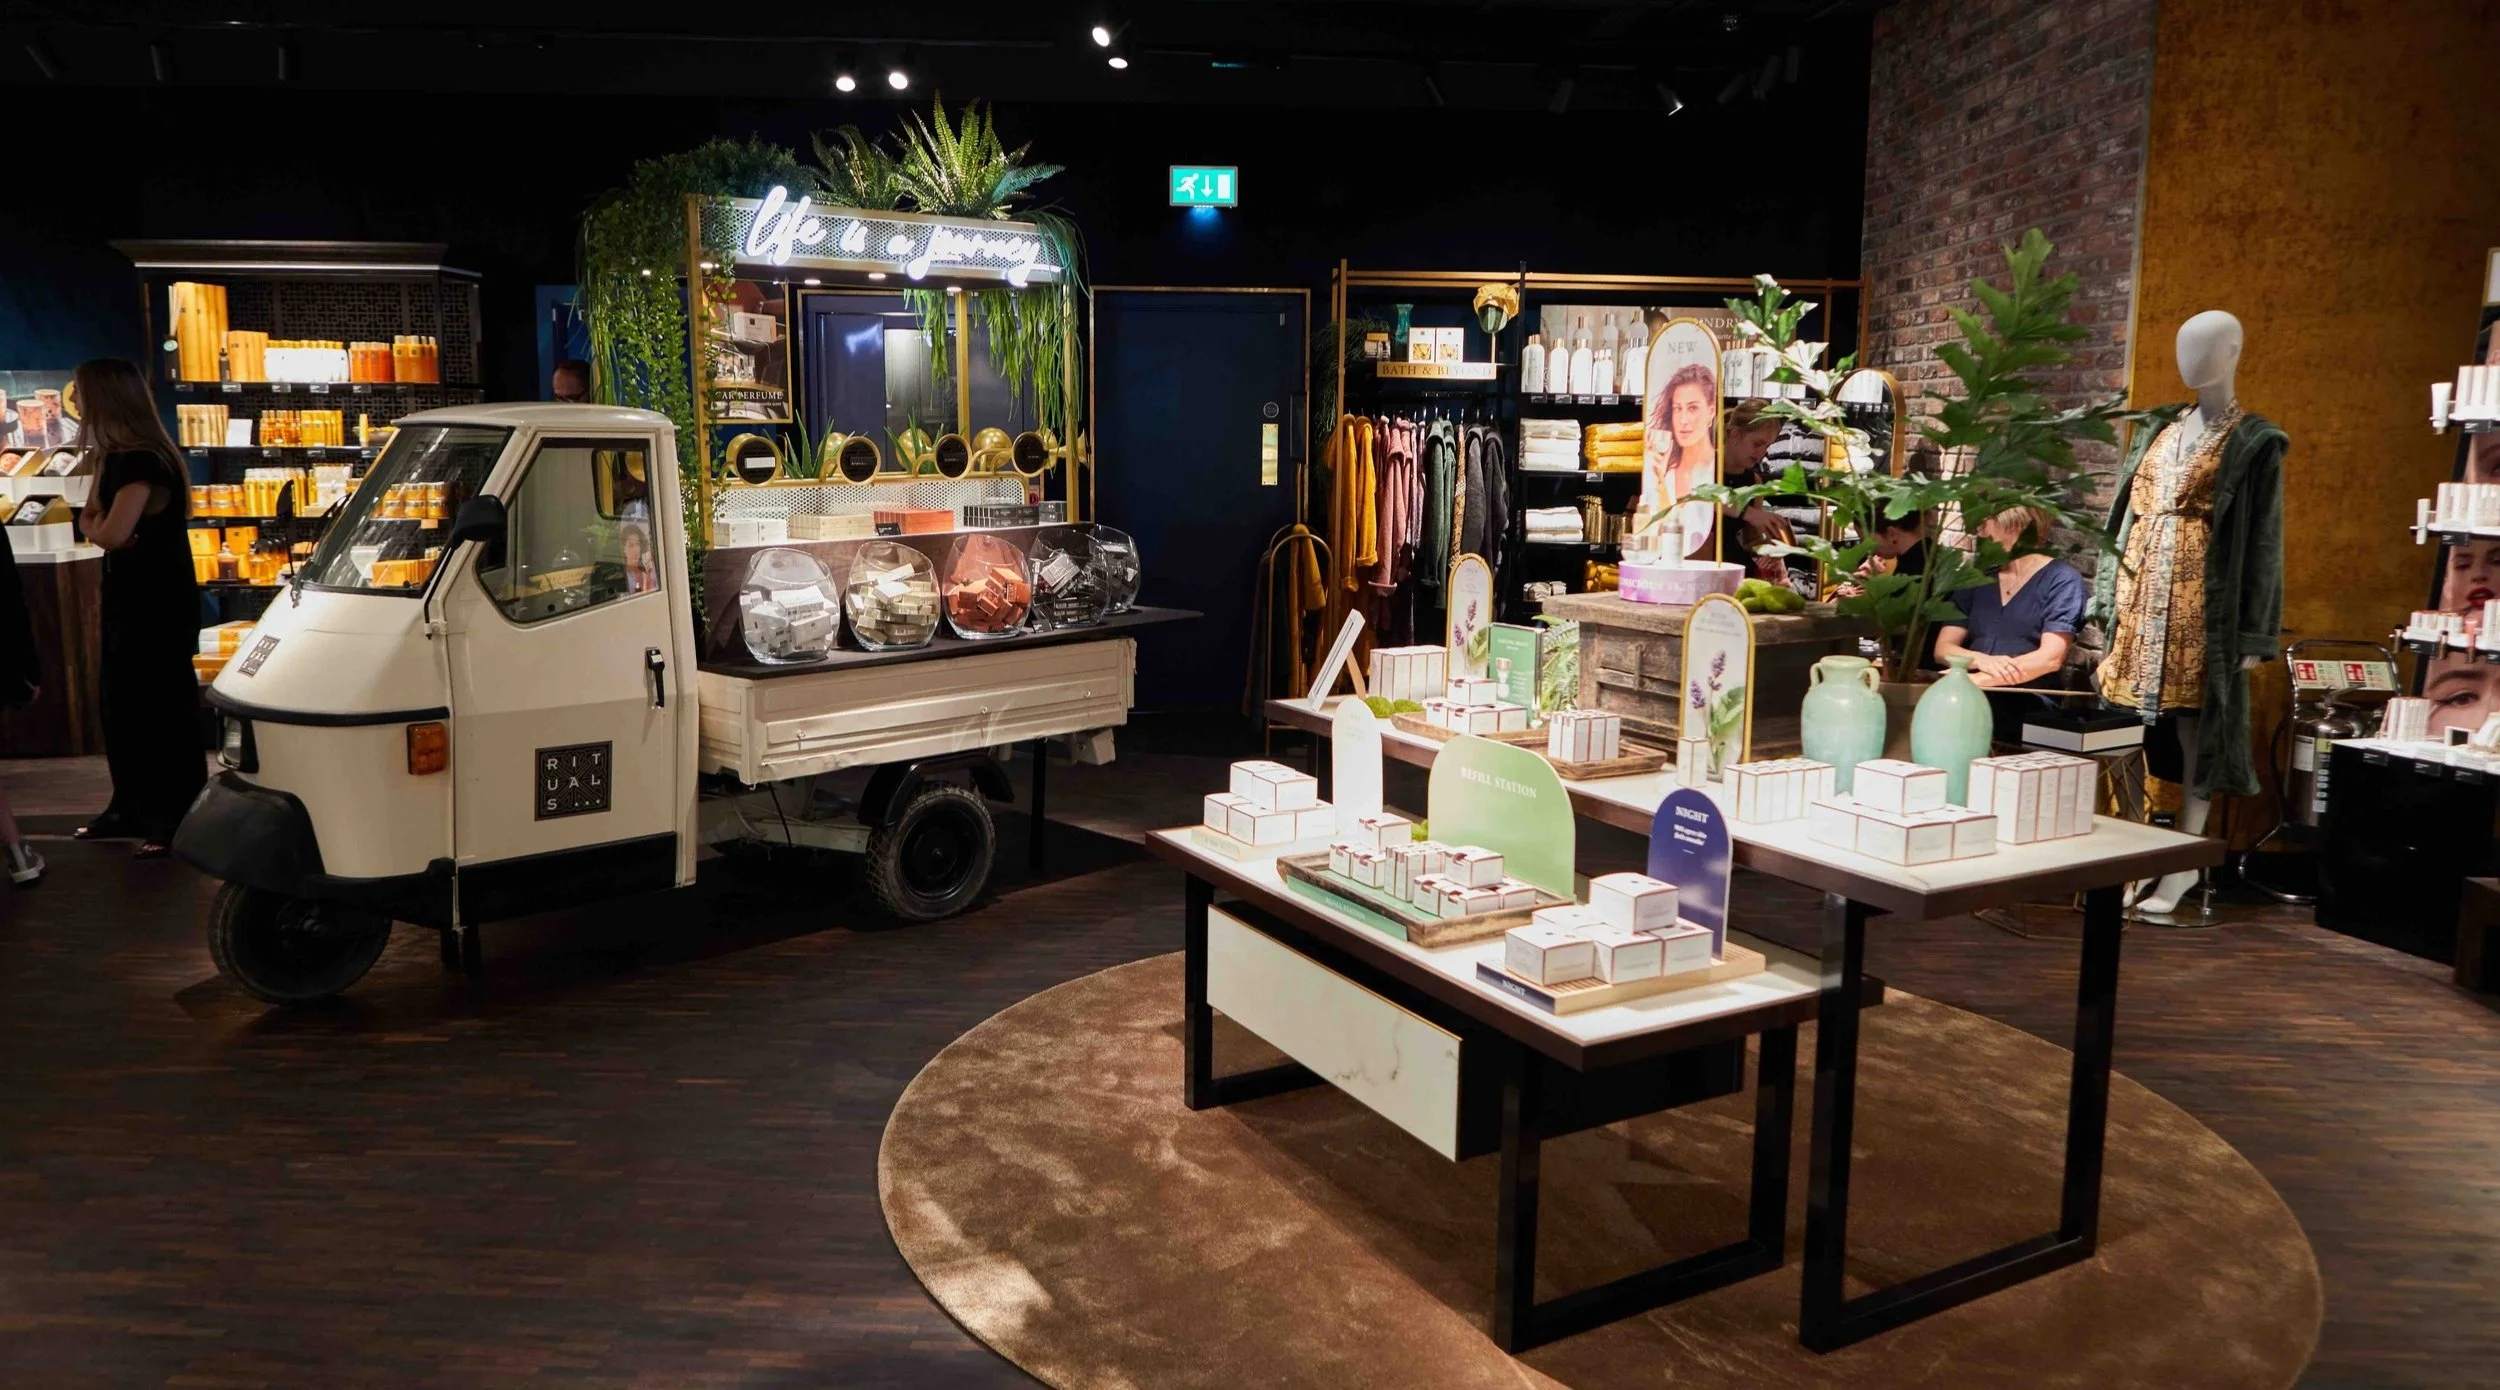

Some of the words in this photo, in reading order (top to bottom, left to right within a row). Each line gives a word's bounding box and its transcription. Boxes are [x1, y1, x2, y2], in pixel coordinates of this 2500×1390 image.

[747, 185, 827, 266] life
[886, 234, 915, 256] a
[1667, 340, 1698, 355] NEW
[1382, 365, 1416, 376] BATH
[1422, 366, 1431, 376] &
[738, 391, 784, 400] PERFUME
[1460, 766, 1492, 786] REFILL
[1494, 776, 1537, 799] STATION
[1675, 805, 1710, 824] NIGHT
